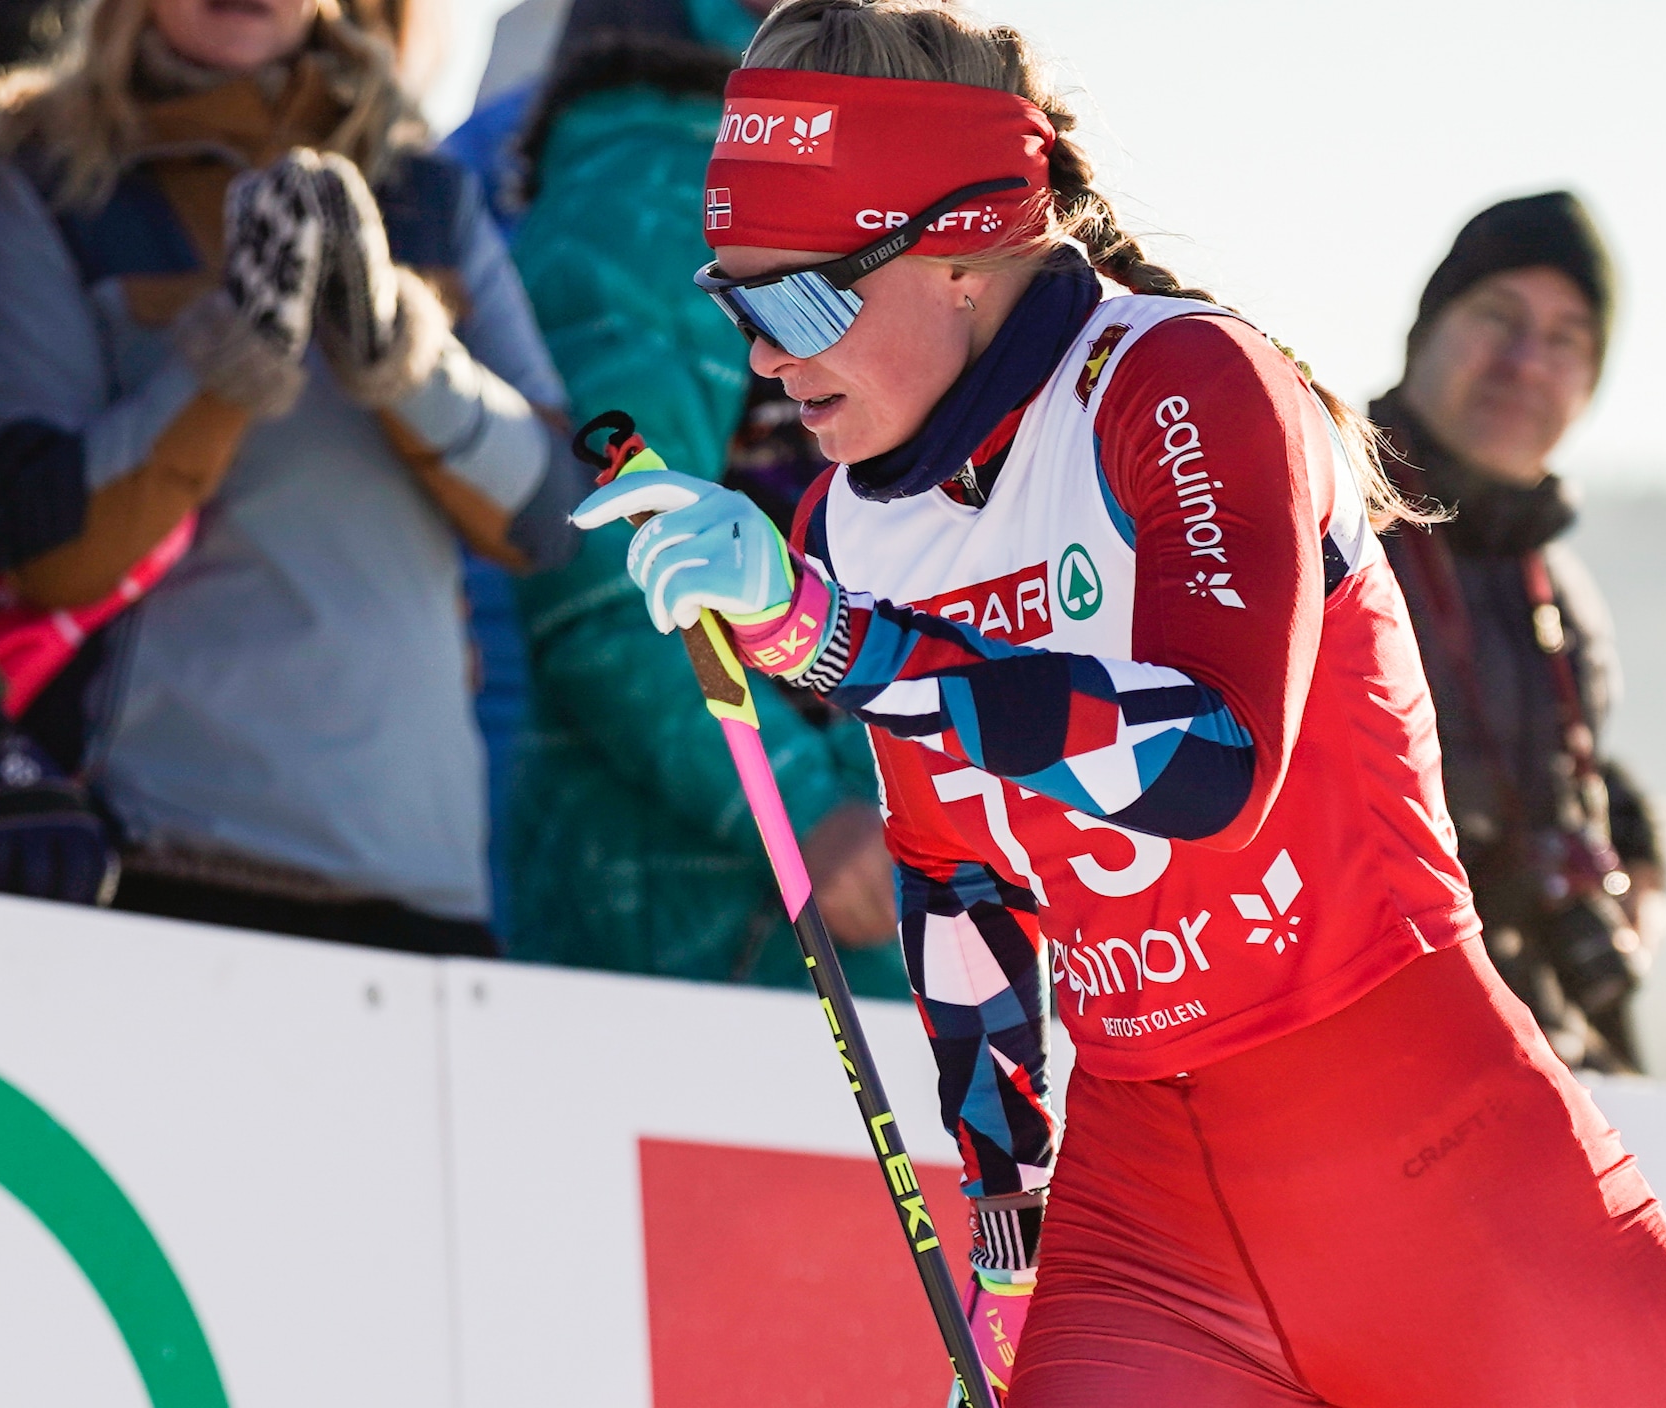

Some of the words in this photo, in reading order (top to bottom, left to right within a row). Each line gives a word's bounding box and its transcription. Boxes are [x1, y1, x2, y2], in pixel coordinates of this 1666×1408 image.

[715, 105, 784, 144] inor
[1155, 395, 1228, 564] equinor
[902, 577, 1048, 637] PAR
[753, 613, 818, 668] EKI
[1101, 999, 1208, 1038] BEITOSTØLEN
[871, 1111, 940, 1253] LEKI
[985, 1307, 1017, 1368] EKI
